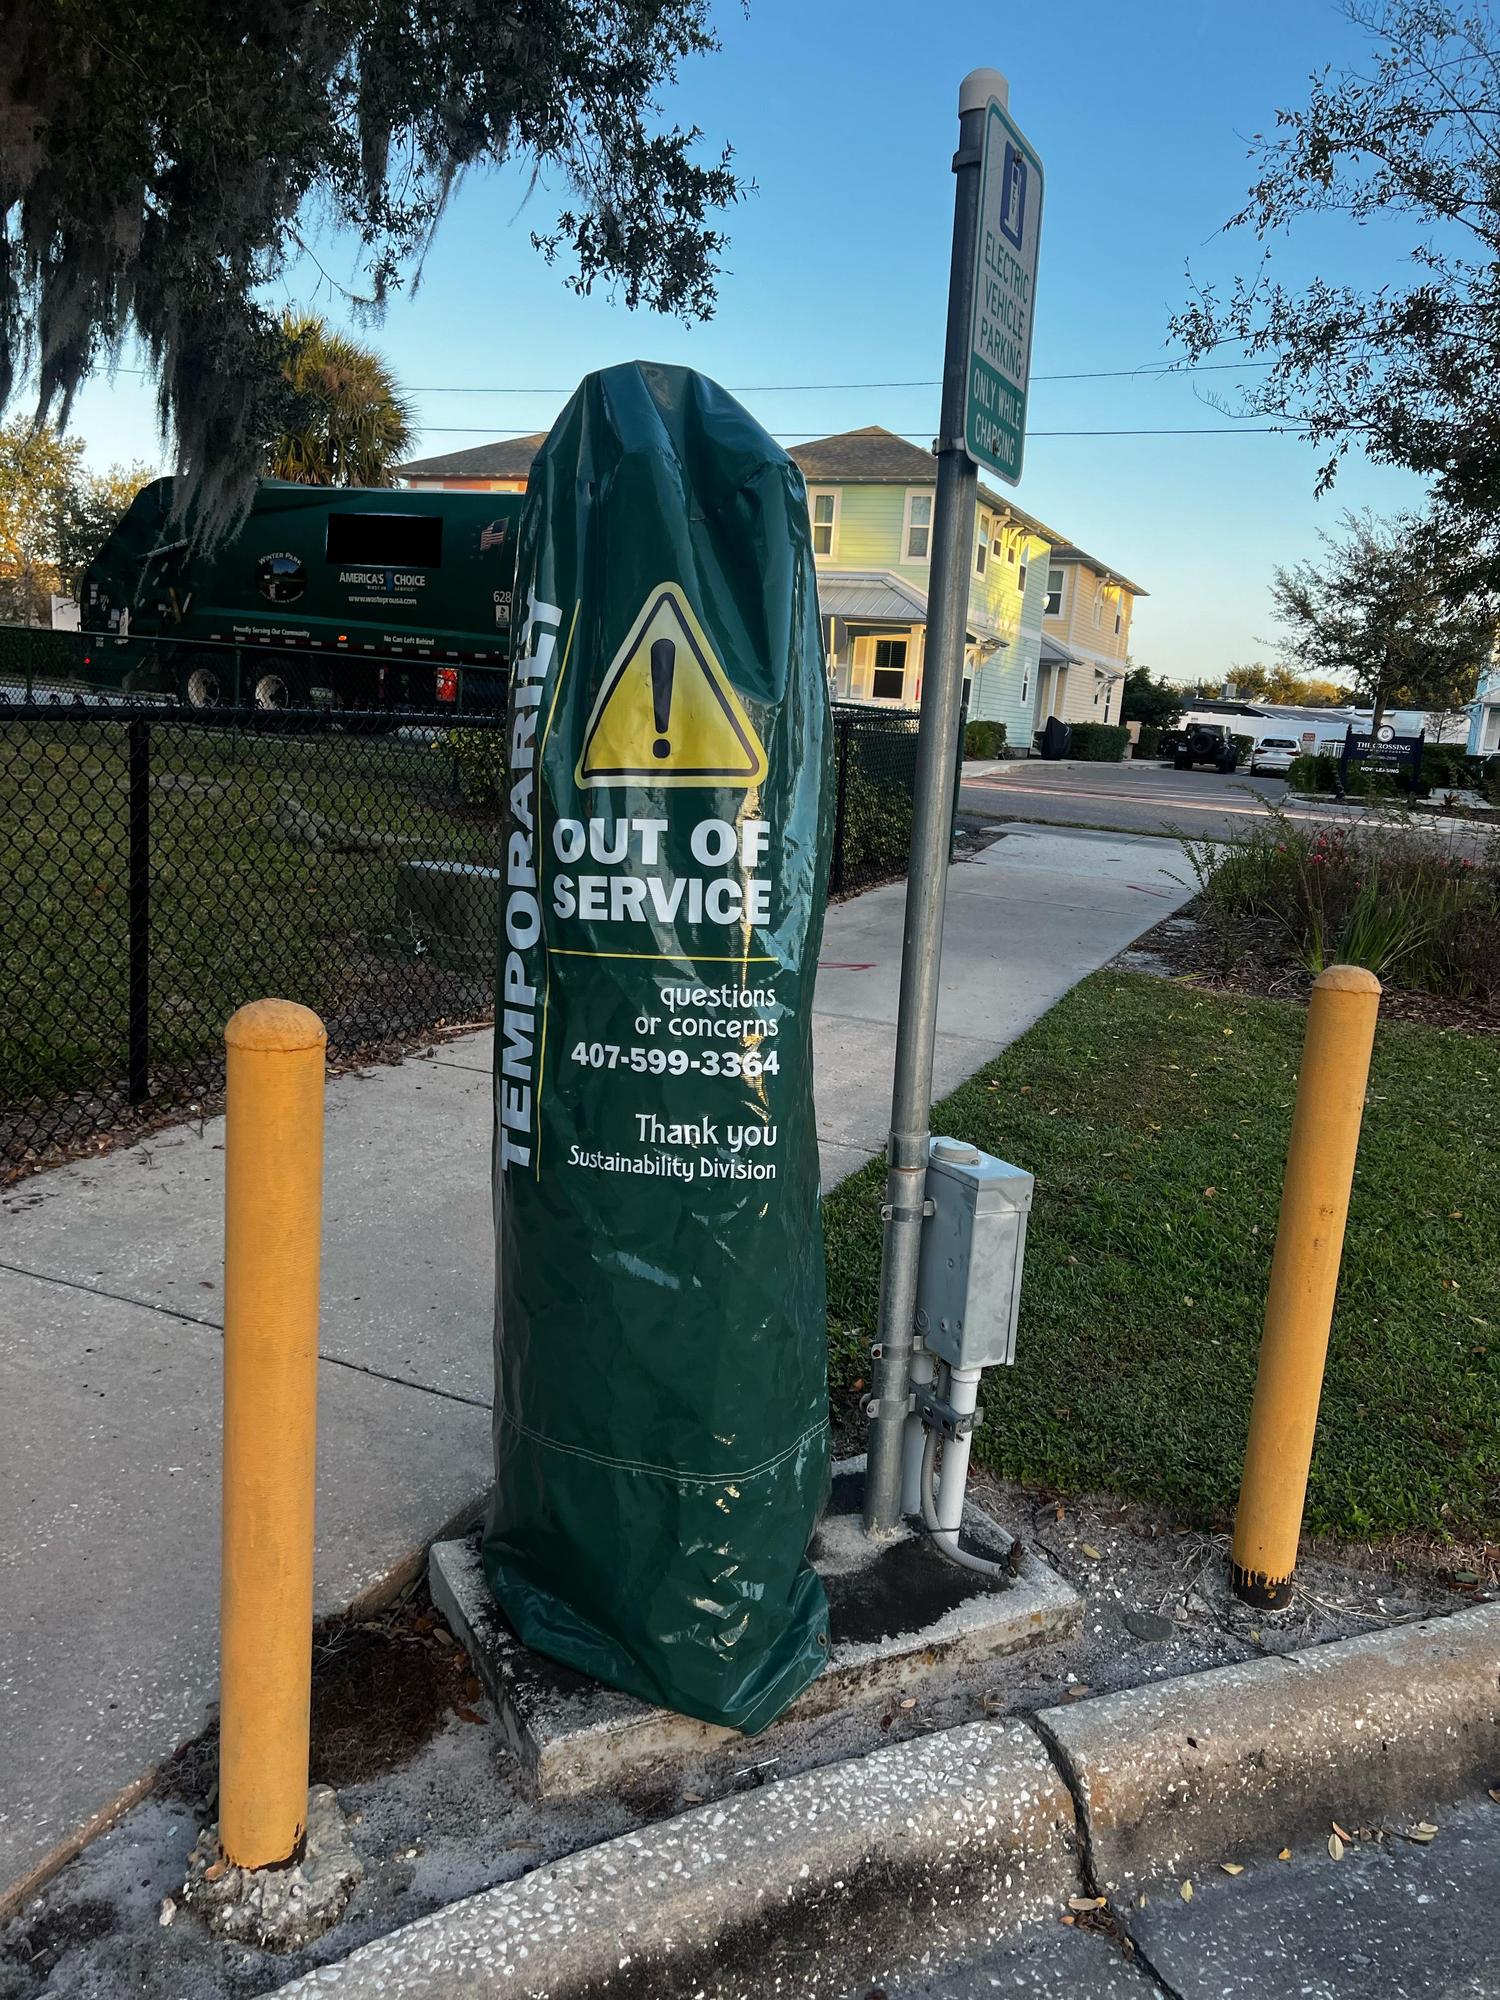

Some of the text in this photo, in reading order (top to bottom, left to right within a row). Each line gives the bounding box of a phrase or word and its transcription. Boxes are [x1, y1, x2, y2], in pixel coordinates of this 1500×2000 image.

[984, 230, 1030, 304] ELECTRIC
[985, 272, 1025, 342] VEHICLE
[980, 316, 1023, 380] PARKING
[973, 367, 1022, 432] ONLY WHILE
[975, 413, 1016, 467] CHARGING
[339, 572, 426, 587] AMERICA'S CHOICE
[493, 590, 512, 603] 628
[233, 625, 252, 635] Proudly
[252, 627, 271, 636] Serving
[281, 629, 311, 639] Community
[392, 635, 403, 643] Can
[403, 636, 415, 644] Left
[415, 637, 435, 646] Behind
[552, 818, 771, 867] OUT OF
[499, 597, 563, 1170] TEMPORARILY
[552, 873, 772, 925] SERVICE
[660, 983, 776, 1013] questions
[634, 1016, 779, 1038] or concerns
[571, 1041, 780, 1078] 407-599-3364
[635, 1113, 778, 1153] Thank you
[567, 1144, 777, 1183] Sustainability Division
